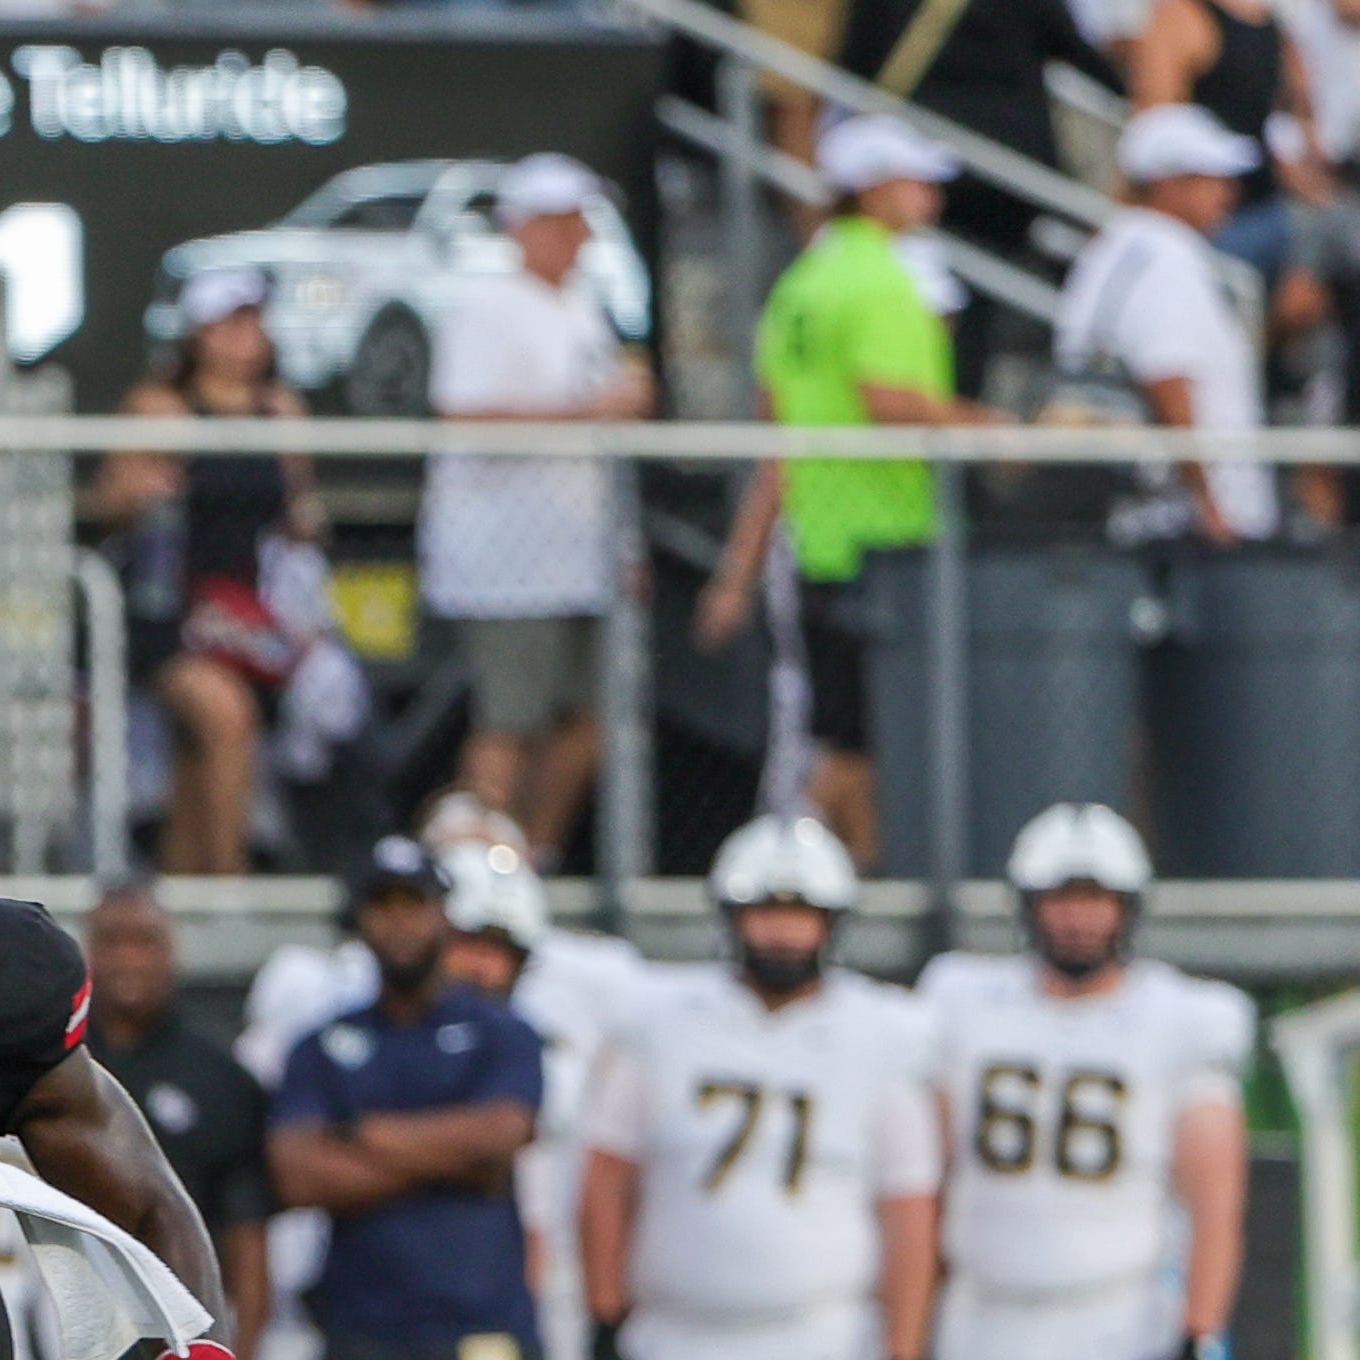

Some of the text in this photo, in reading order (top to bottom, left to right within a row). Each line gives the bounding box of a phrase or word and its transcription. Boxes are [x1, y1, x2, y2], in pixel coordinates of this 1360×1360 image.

[10, 44, 348, 146] Telluride
[694, 1078, 815, 1197] 71
[975, 1060, 1129, 1182] 66
